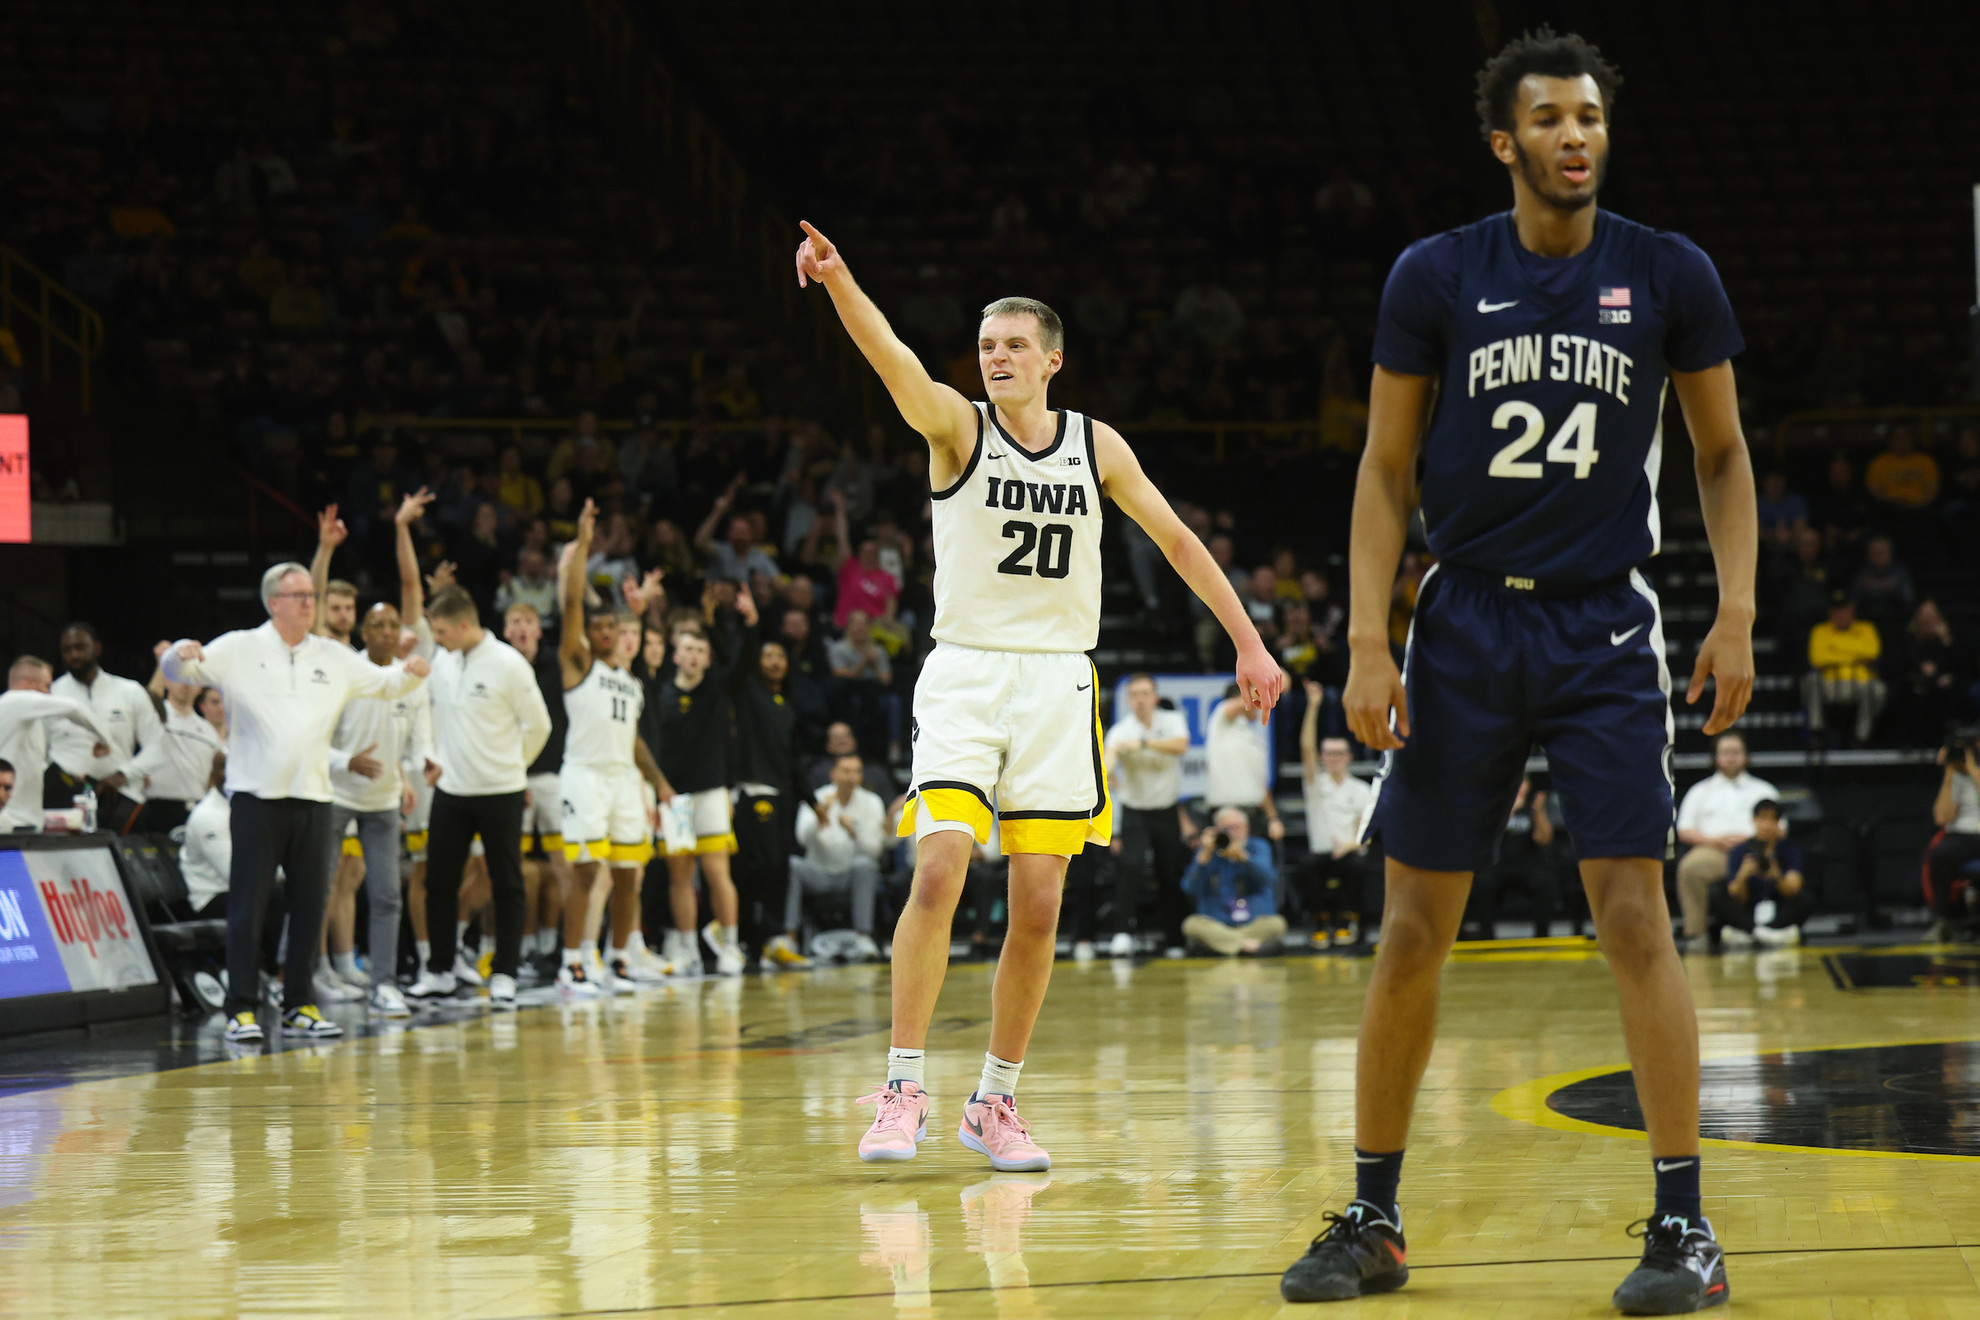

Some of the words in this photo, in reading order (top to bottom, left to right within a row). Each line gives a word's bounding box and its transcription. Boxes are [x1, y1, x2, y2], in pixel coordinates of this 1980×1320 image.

[1469, 333, 1543, 398] PENN
[1550, 333, 1634, 406] STATE
[1488, 400, 1600, 479] 24
[985, 476, 1088, 516] IOWA
[997, 520, 1073, 579] 20
[1505, 576, 1535, 590] PSU
